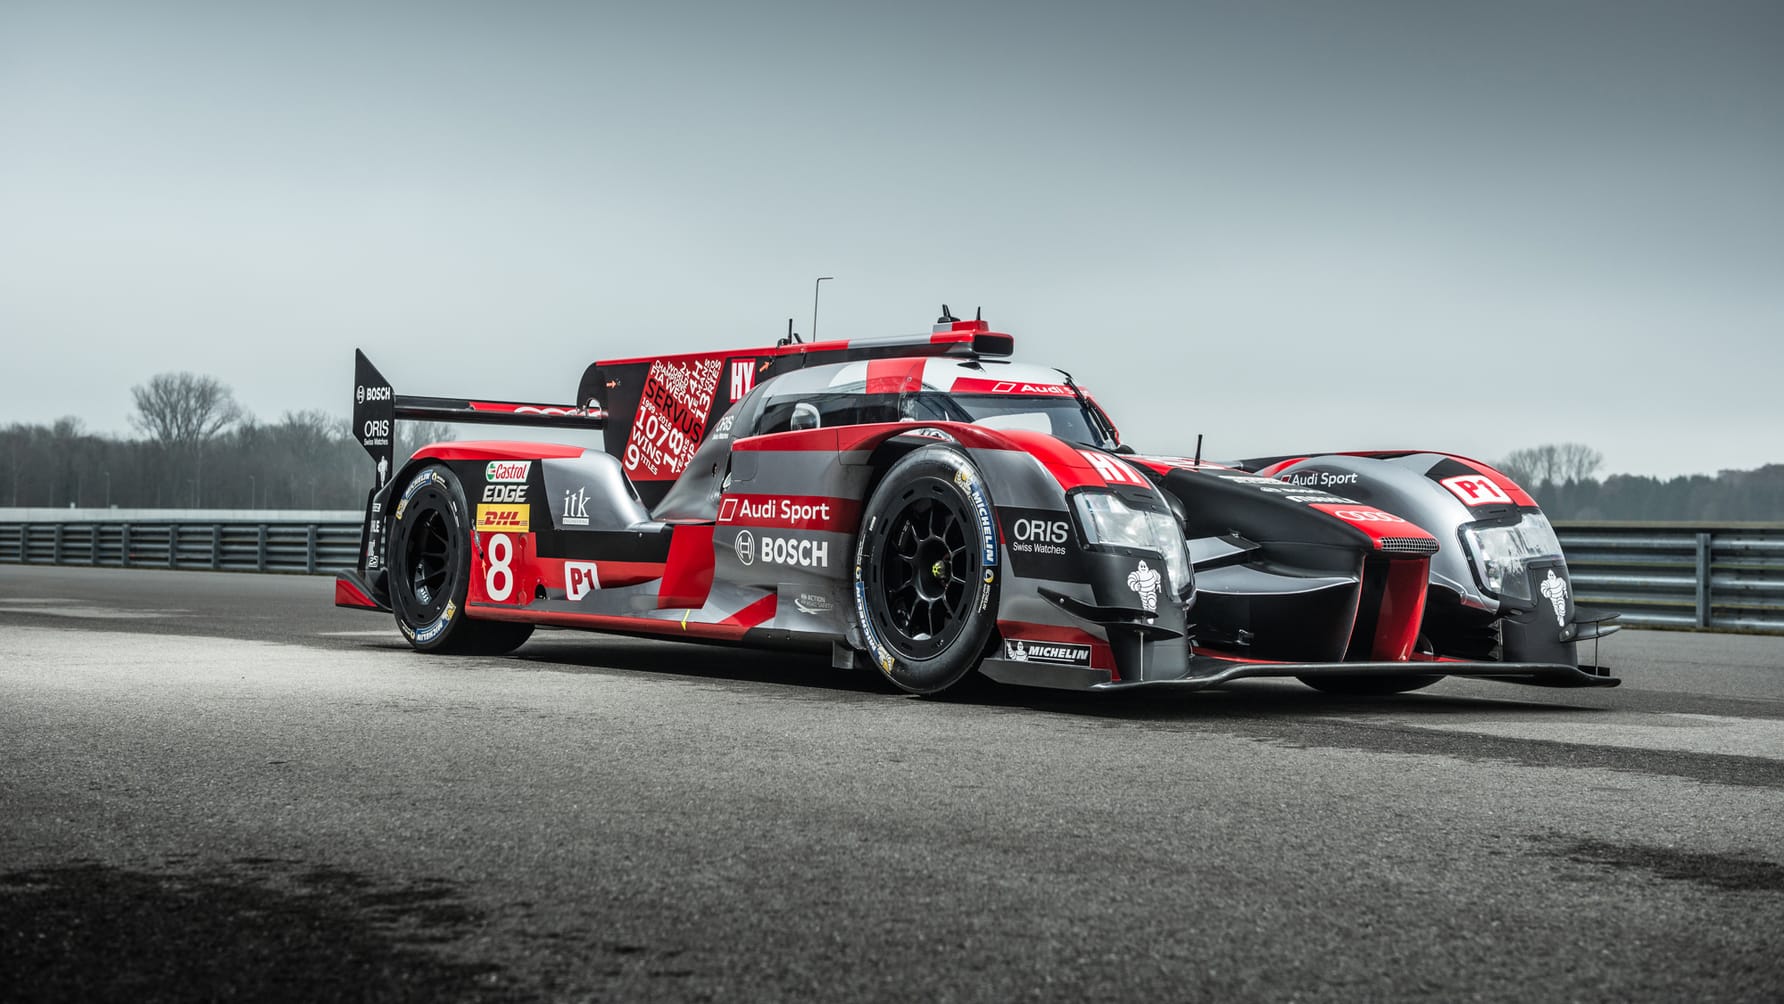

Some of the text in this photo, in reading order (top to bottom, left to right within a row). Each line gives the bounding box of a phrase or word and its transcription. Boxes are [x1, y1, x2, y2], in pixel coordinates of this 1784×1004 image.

[651, 365, 683, 404] FIA WEC
[667, 361, 688, 386] WORLD
[731, 361, 755, 400] HY
[366, 387, 390, 401] BOSCH
[1021, 384, 1064, 394] Audi
[645, 378, 702, 443] SERVUS
[658, 413, 673, 431] 2016
[364, 420, 389, 438] ORIS
[625, 444, 640, 471] 9
[632, 426, 663, 466] WINS
[495, 463, 527, 480] Castrol
[640, 453, 658, 476] TITLES
[1082, 451, 1142, 484] HY
[1292, 473, 1318, 487] Audi
[1320, 472, 1358, 488] Sport
[1456, 480, 1501, 498] P1
[482, 485, 530, 503] EDGE
[562, 486, 591, 517] itk
[485, 511, 520, 526] DHL
[739, 499, 830, 524] Audi Sport
[971, 491, 995, 563] MICHELIN
[1013, 518, 1069, 543] ORIS
[761, 536, 828, 568] BOSCH
[1012, 542, 1066, 555] Swiss Watches
[486, 533, 513, 601] 8
[570, 568, 596, 596] P1
[1028, 645, 1089, 661] MICHELIN
